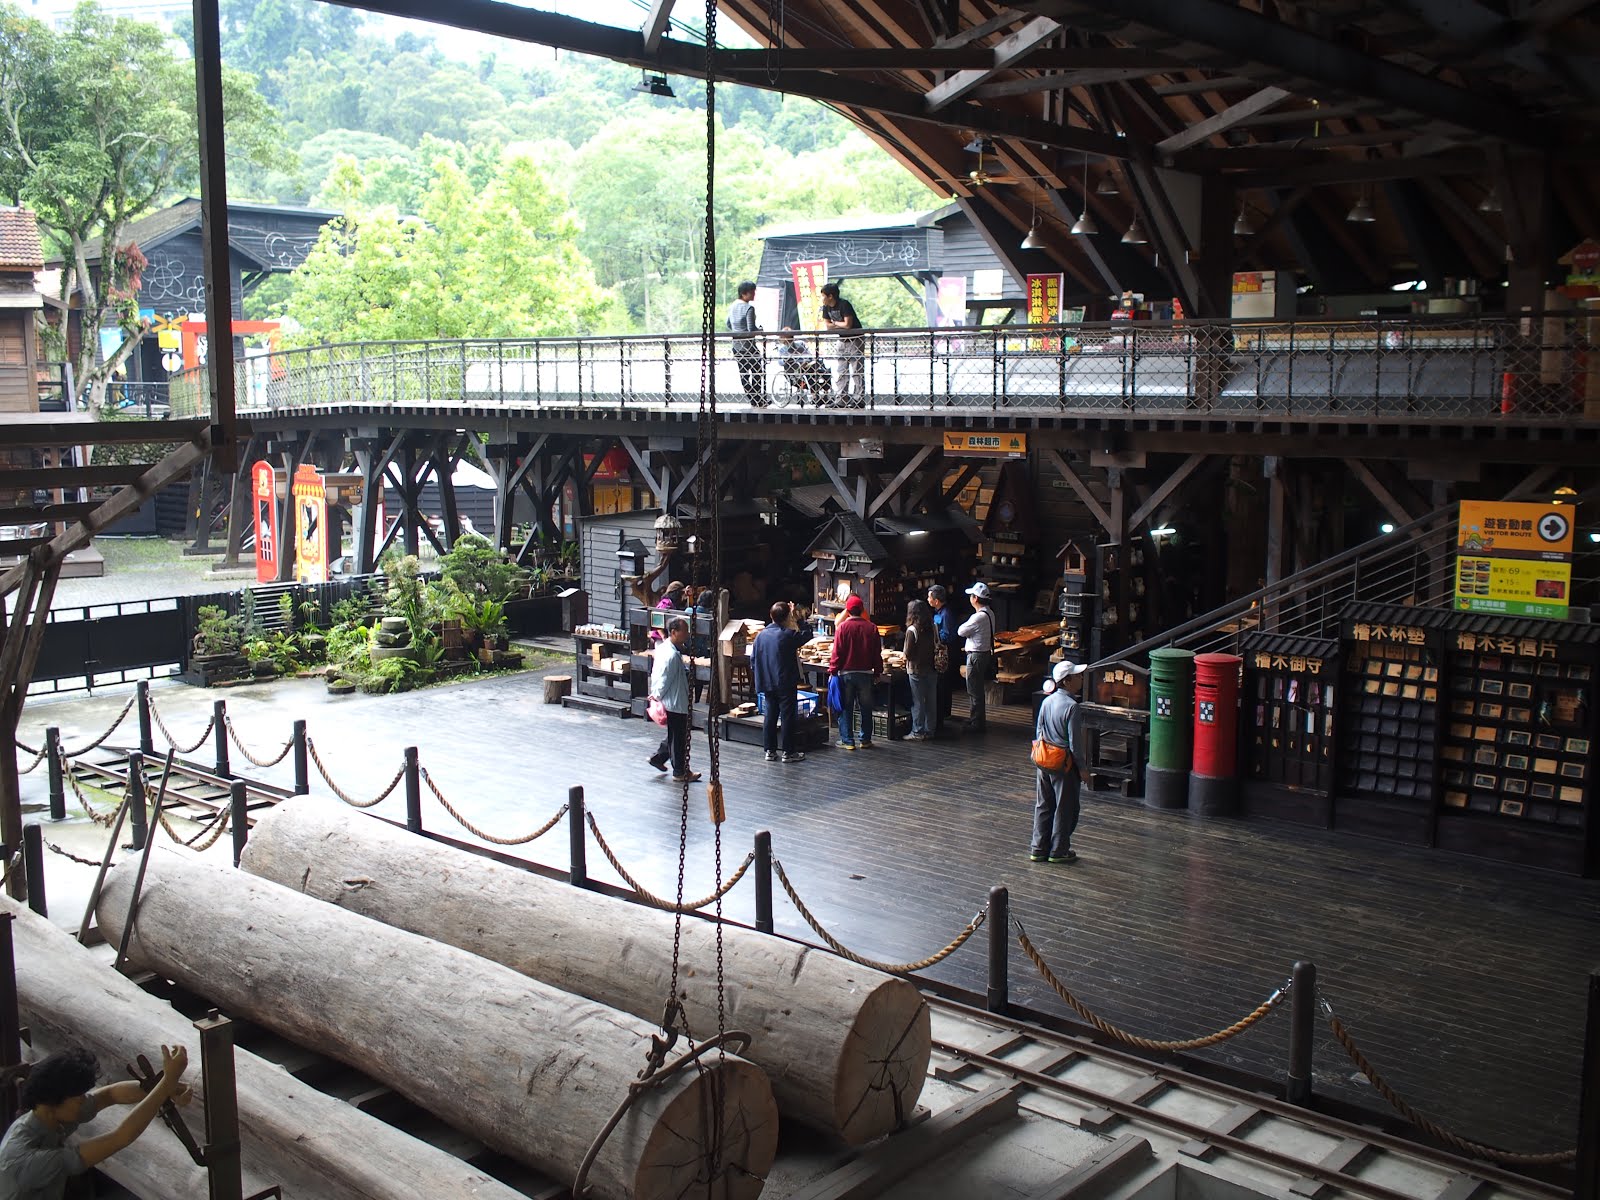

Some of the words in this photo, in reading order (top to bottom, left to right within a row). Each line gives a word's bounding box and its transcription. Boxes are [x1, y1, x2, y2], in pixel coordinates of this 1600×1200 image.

[968, 437, 1000, 446] 森林超市
[1484, 517, 1533, 530] 遊客動線
[1353, 622, 1426, 646] 檜木杯墊
[1457, 631, 1559, 658] 檜木名信片
[1255, 651, 1323, 675] 檜木御守
